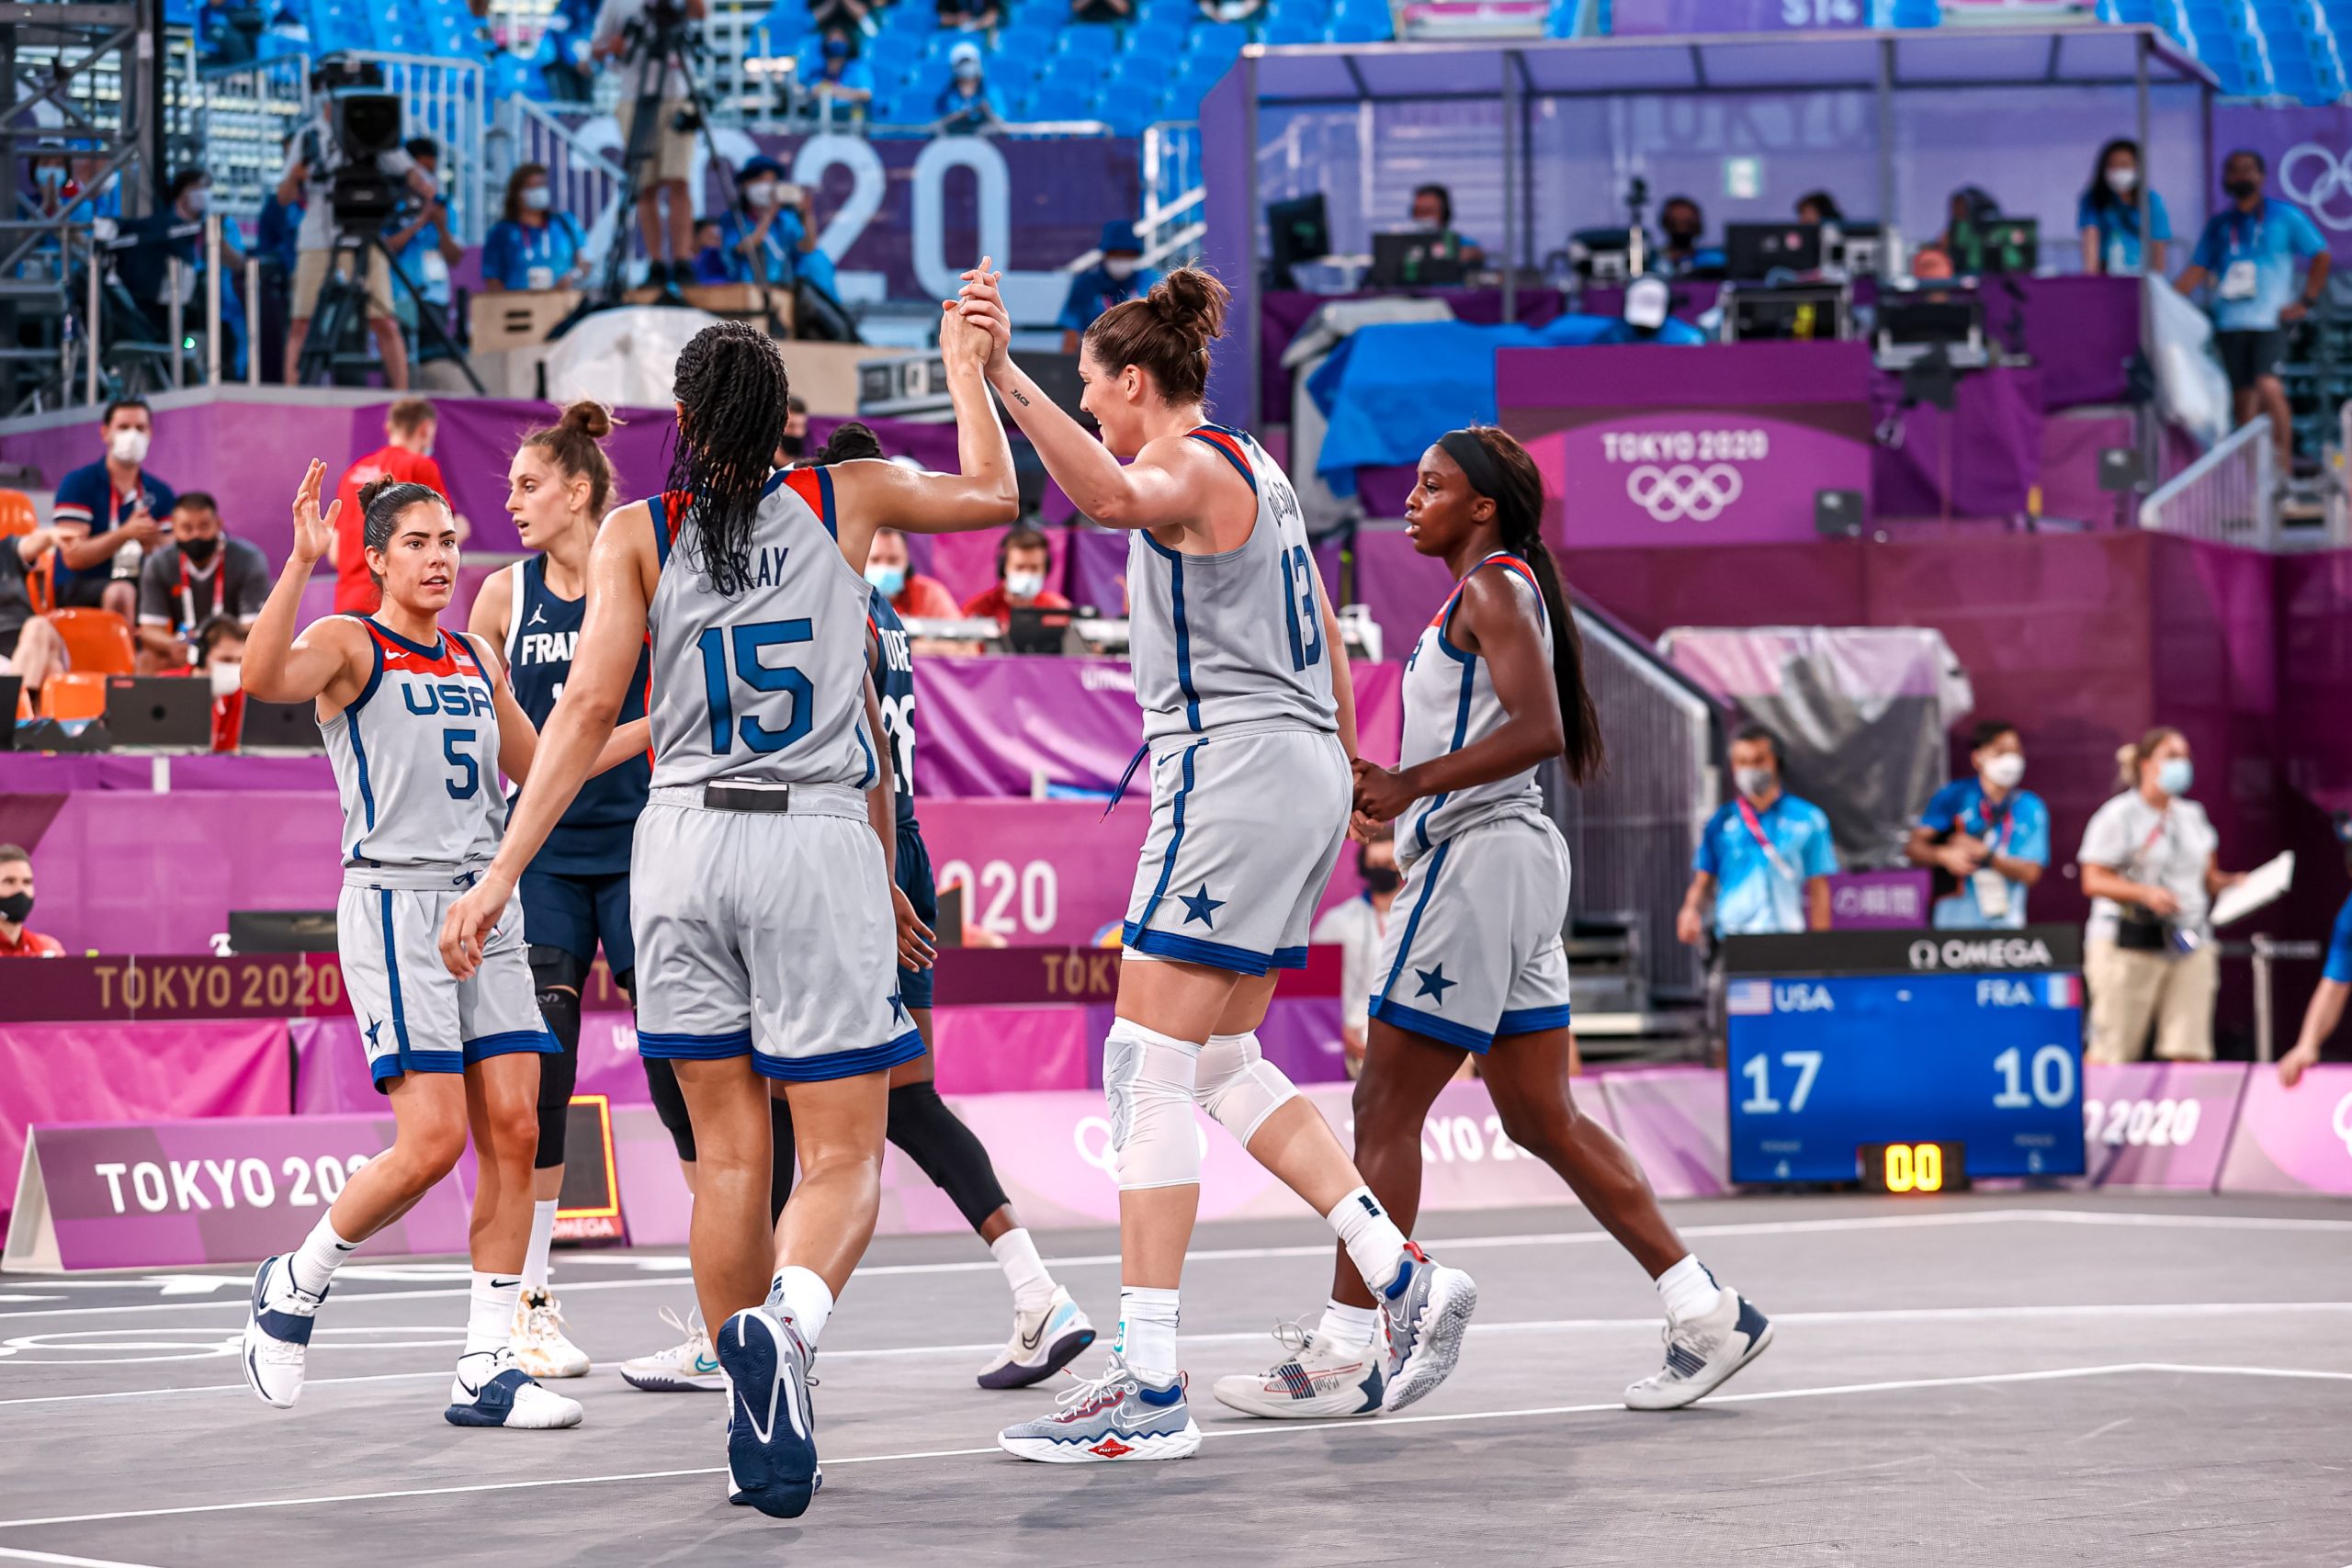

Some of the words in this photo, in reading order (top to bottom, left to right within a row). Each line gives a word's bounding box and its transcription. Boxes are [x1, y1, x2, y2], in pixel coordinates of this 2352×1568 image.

[1011, 389, 1030, 407] JACS
[1601, 432, 1696, 462] TOKYO
[1698, 429, 1769, 460] 2020
[1281, 545, 1321, 672] 13
[401, 682, 495, 720] USA
[696, 617, 814, 755] 15
[443, 728, 479, 799] 5
[1942, 938, 2052, 969] OMEGA
[95, 966, 231, 1009] TOKYO
[241, 964, 340, 1007] 2020
[1774, 985, 1835, 1012] USA
[1976, 980, 2034, 1006] FRA
[1743, 1051, 1823, 1113] 17
[1993, 1044, 2075, 1108] 10
[2101, 1098, 2201, 1146] 2020
[95, 1156, 276, 1213] TOKYO
[1884, 1144, 1942, 1192] 00
